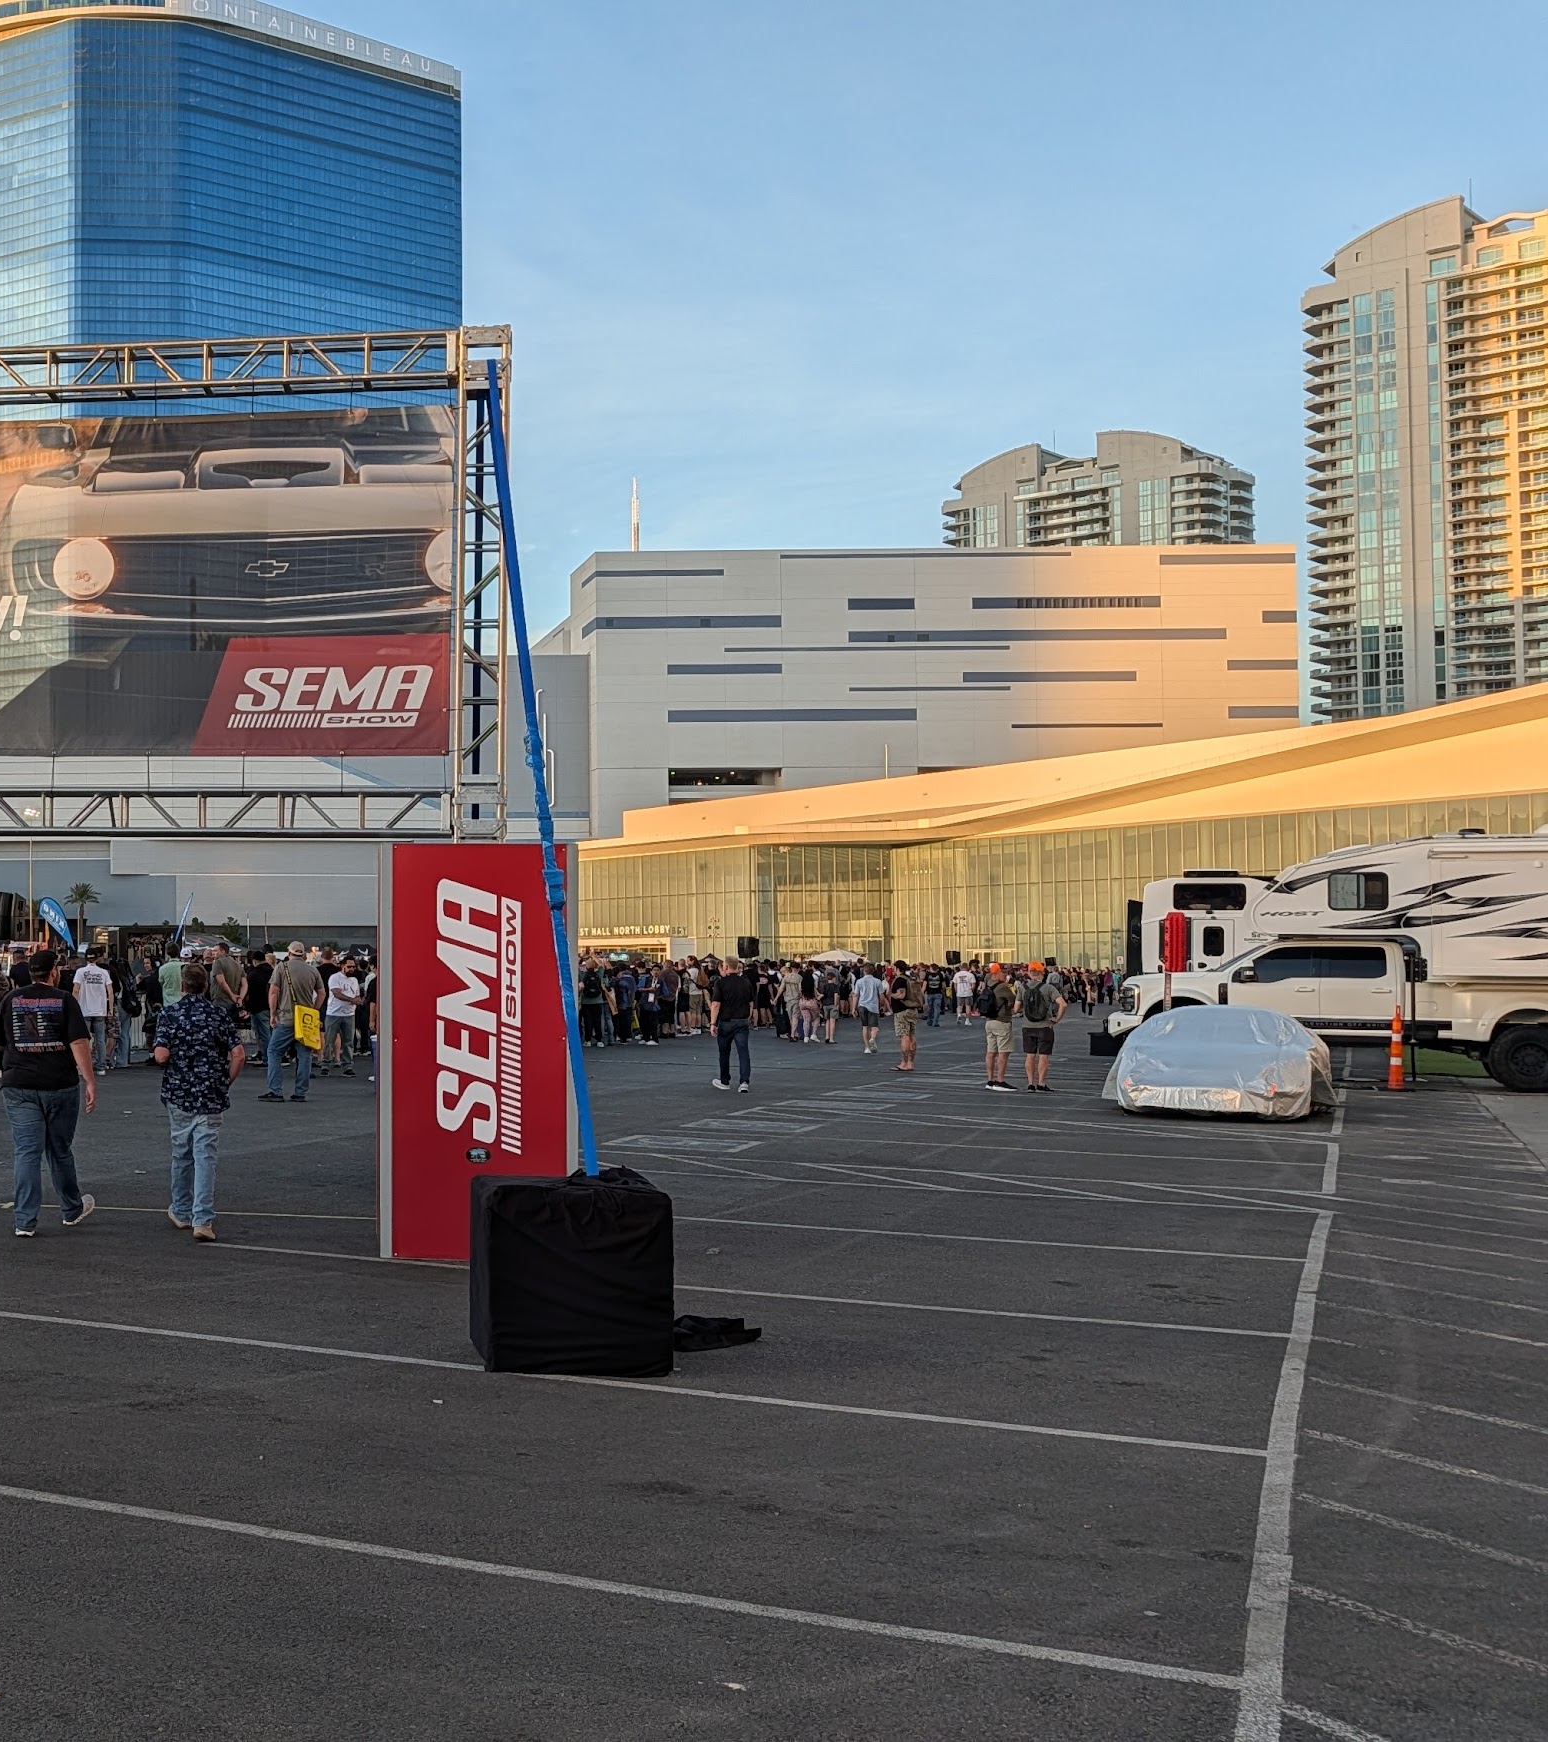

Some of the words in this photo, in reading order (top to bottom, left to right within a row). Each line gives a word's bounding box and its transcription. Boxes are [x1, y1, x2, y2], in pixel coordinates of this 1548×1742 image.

[235, 664, 434, 712] SEMA
[326, 715, 414, 724] SHOW
[592, 927, 611, 936] HALL
[613, 926, 640, 936] NORTH
[643, 925, 671, 935] LOBBY
[436, 878, 498, 1144] SEMA
[505, 902, 517, 1020] SHOW
